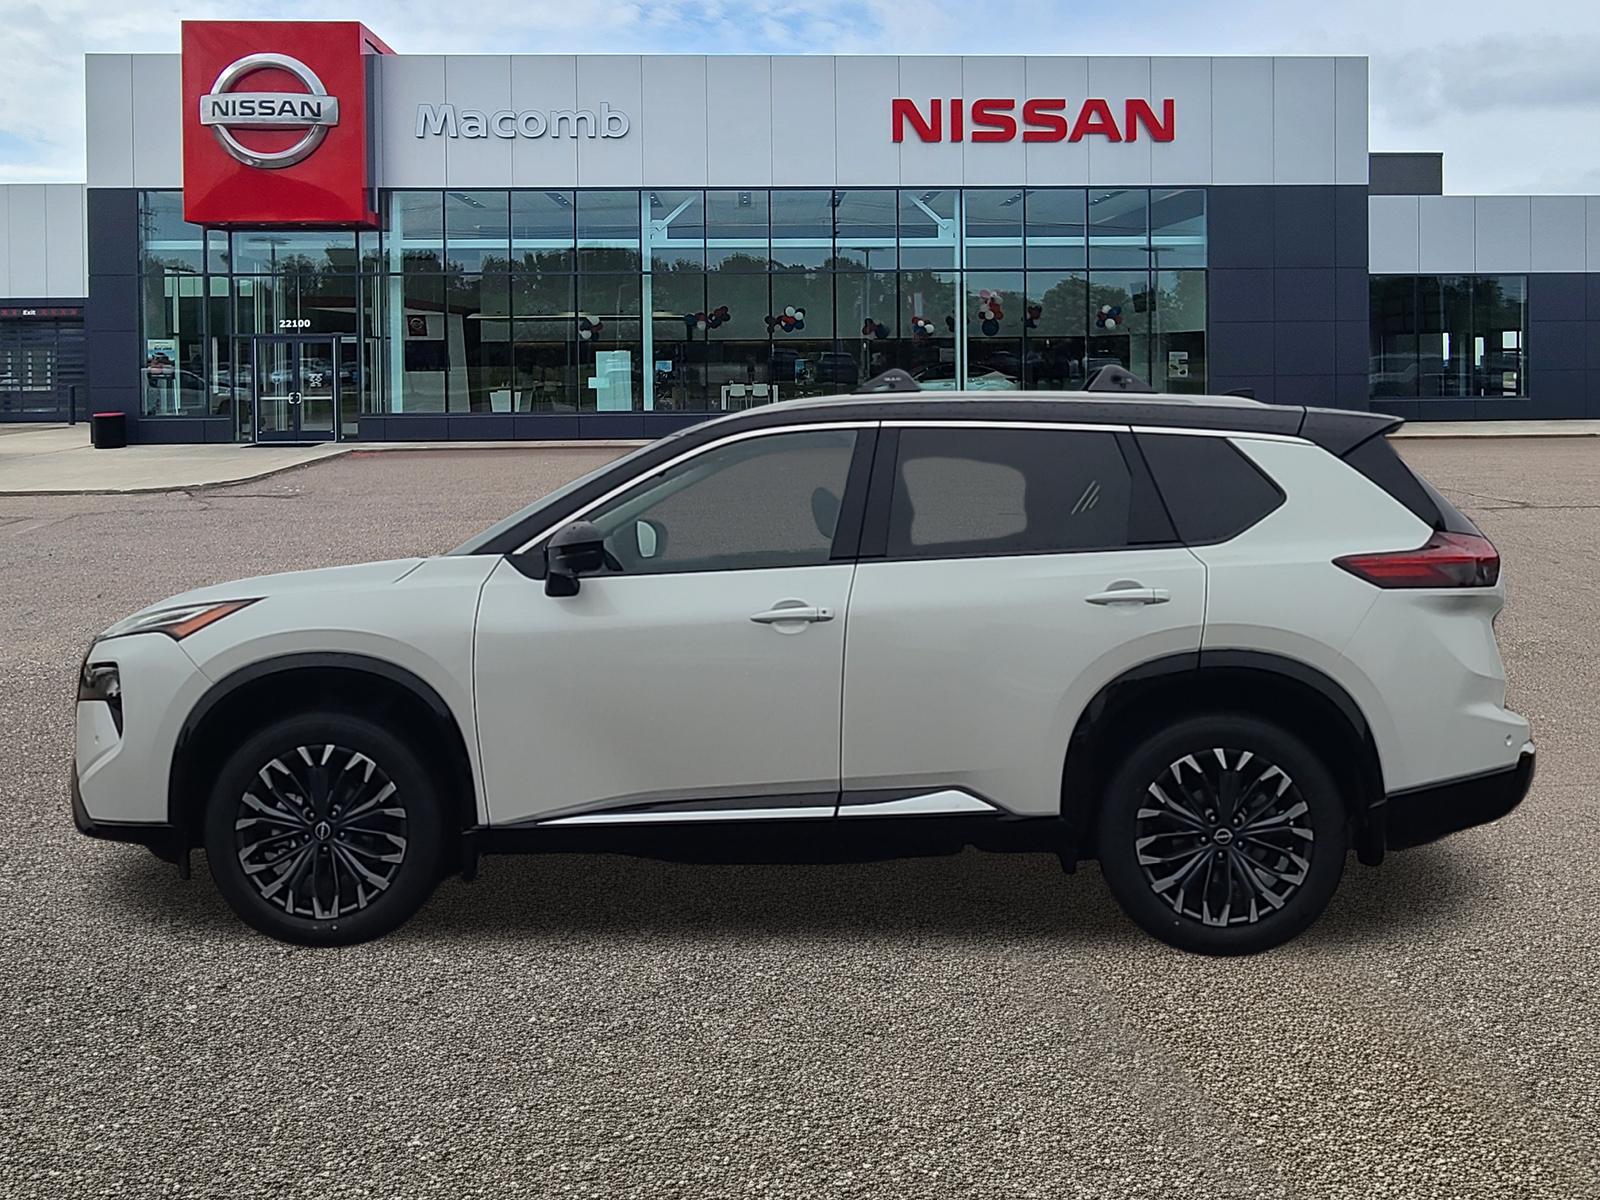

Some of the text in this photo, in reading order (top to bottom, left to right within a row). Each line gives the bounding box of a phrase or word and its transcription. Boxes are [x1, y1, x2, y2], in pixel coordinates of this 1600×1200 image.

[211, 99, 322, 118] NISSAN
[415, 101, 630, 139] Macomb
[891, 98, 1176, 144] NISSAN
[279, 319, 311, 328] 22100
